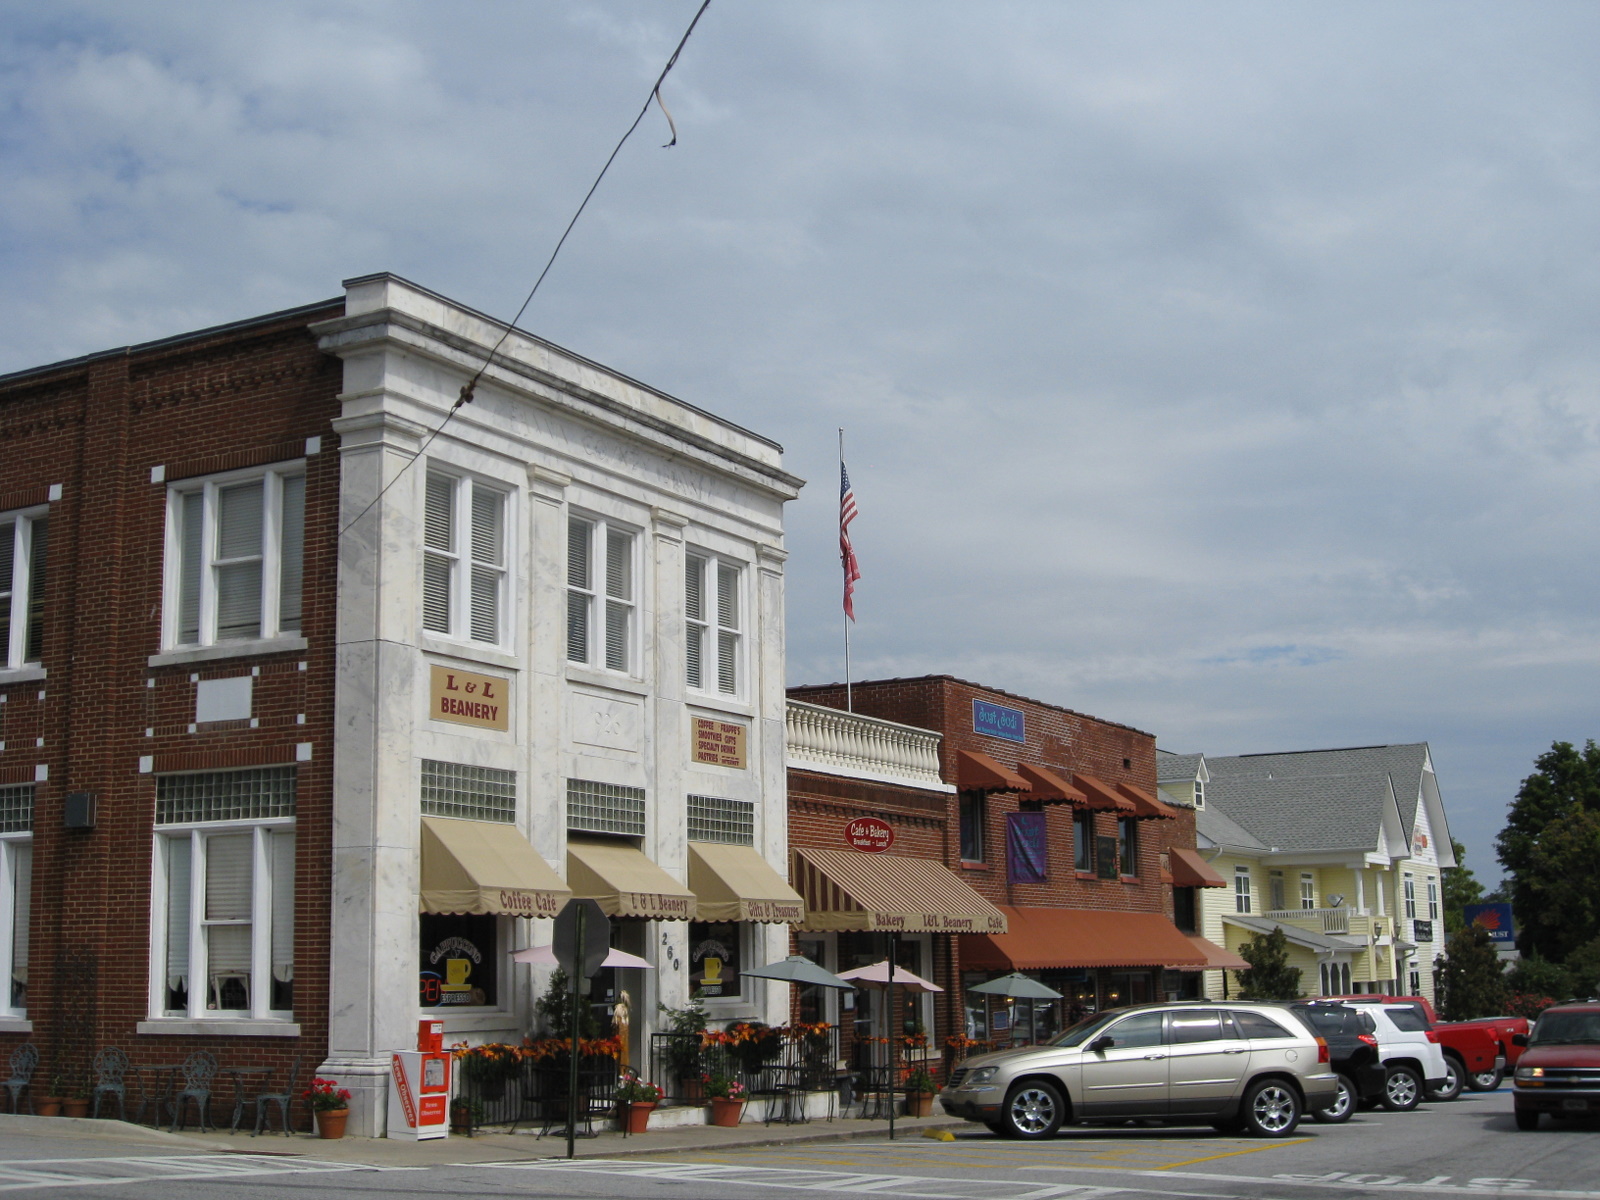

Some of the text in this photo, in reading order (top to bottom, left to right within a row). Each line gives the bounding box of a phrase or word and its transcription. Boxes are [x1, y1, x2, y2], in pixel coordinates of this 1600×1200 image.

[446, 675, 494, 698] L & L
[441, 697, 498, 720] BEANERY
[698, 719, 714, 730] COFFEE
[698, 729, 736, 745] SMOOTHIES GIFTS
[698, 740, 736, 755] SPECIALTY DRINKS
[698, 751, 718, 763] PASTRIES
[870, 825, 889, 842] Bakery
[500, 890, 557, 912] Coffee Café
[657, 894, 688, 916] Beanery
[747, 901, 764, 918] Gifts
[771, 902, 800, 918] Treasures
[875, 913, 906, 929] Bakery
[943, 915, 973, 931] Beanery
[430, 937, 481, 964] CAPPUCCINO
[440, 993, 471, 1004] ESPRESSO
[399, 1083, 416, 1123] Observer
